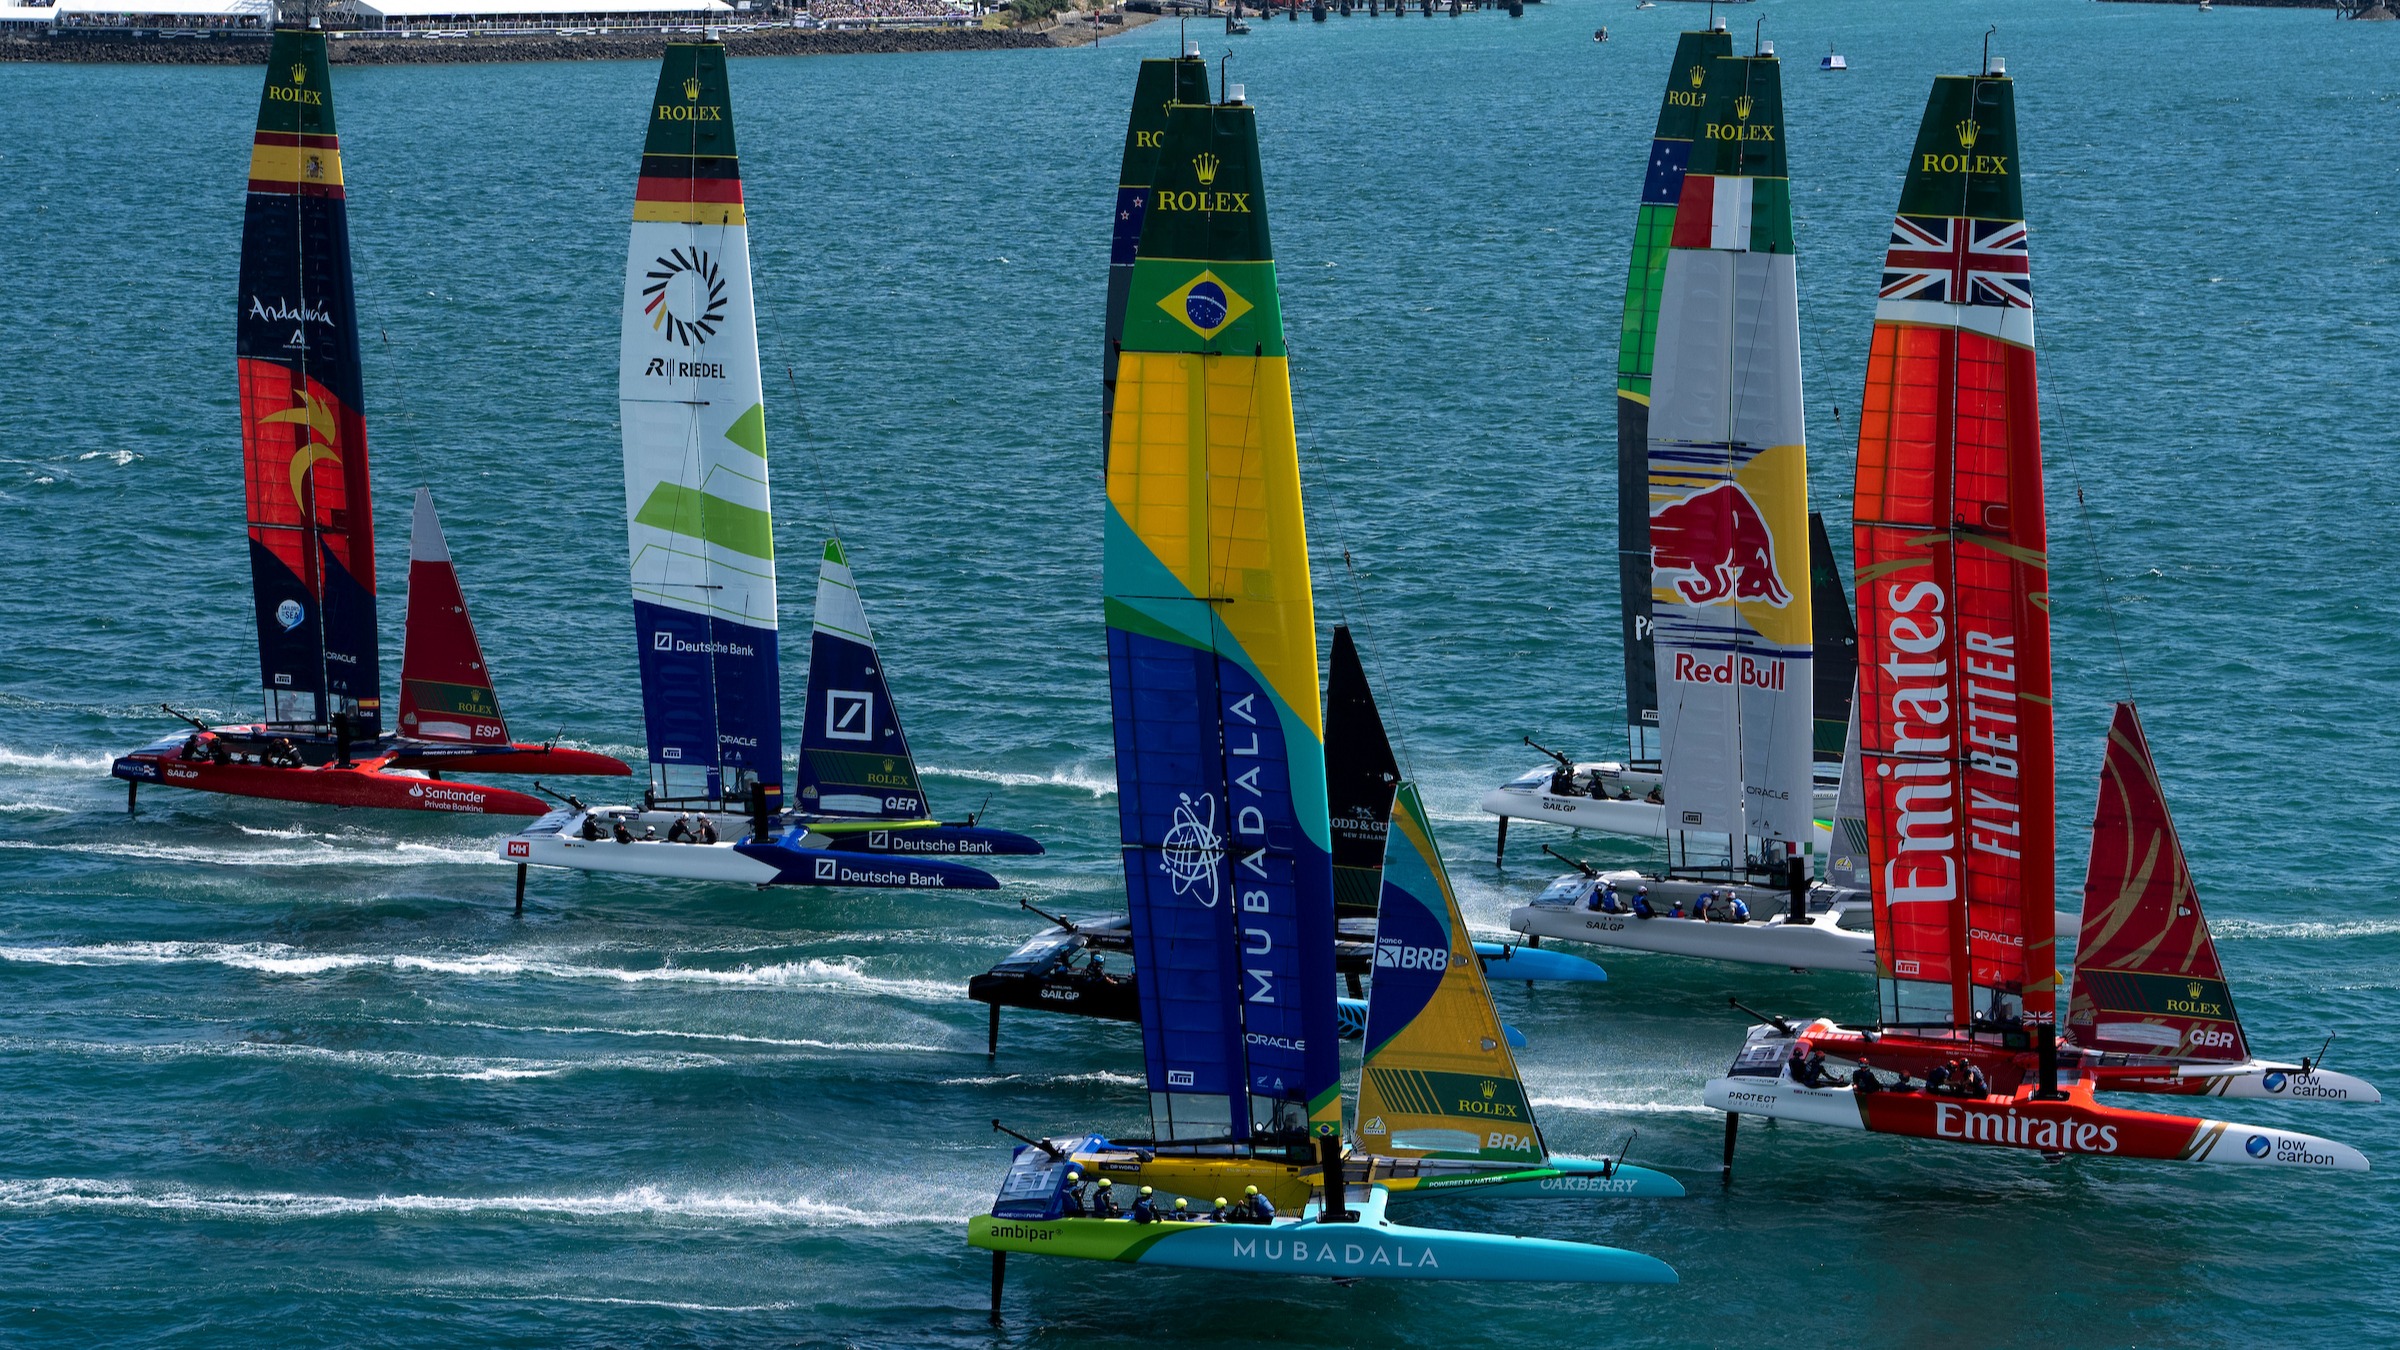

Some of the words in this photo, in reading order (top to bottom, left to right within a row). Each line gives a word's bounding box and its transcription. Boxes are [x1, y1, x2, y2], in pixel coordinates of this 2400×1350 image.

[269, 86, 322, 105] ROLEX
[1668, 90, 1707, 107] ROL
[658, 105, 721, 121] ROLEX
[1705, 123, 1775, 141] ROLEX
[1921, 153, 2008, 175] ROLEX
[1157, 191, 1251, 213] ROLEX
[249, 295, 335, 326] Andalucía
[678, 362, 726, 379] RIEDEL
[285, 611, 299, 620] SEA
[326, 651, 357, 663] ORACLE
[676, 640, 728, 654] Deutsche
[729, 643, 754, 657] Bank
[1675, 652, 1734, 684] Red
[1740, 654, 1785, 691] Bull
[458, 702, 492, 715] ROLEX
[1966, 629, 2019, 779] BETTER
[475, 724, 501, 738] ESP
[719, 734, 757, 747] ORACLE
[1877, 581, 1957, 907] Emirates
[867, 773, 908, 786] ROLEX
[425, 787, 486, 803] Santander
[1746, 786, 1789, 800] ORACLE
[425, 800, 452, 810] Private
[452, 802, 484, 813] Banking
[885, 796, 918, 811] GER
[1330, 817, 1359, 830] ODD
[1360, 820, 1369, 830] &
[1370, 821, 1388, 832] GU
[1971, 788, 2020, 860] FLY
[893, 838, 955, 852] Deutsche
[959, 840, 993, 853] Bank
[1229, 693, 1275, 1003] MUBADALA
[841, 868, 906, 885] Deutsche
[909, 871, 944, 886] Bank
[1379, 936, 1402, 945] banco
[1969, 928, 2023, 947] ORACLE
[1401, 948, 1448, 970] BRB
[2167, 1000, 2222, 1016] ROLEX
[1245, 1033, 1305, 1051] ORACLE
[2189, 1029, 2234, 1049] GBR
[2292, 1074, 2320, 1085] low
[1728, 1091, 1777, 1103] PROTECT
[2292, 1084, 2347, 1099] carbon
[1458, 1099, 1518, 1118] ROLEX
[1744, 1101, 1775, 1109] FUTURE
[1935, 1102, 2118, 1153] Emirates
[1487, 1132, 1532, 1153] BRA
[2277, 1136, 2306, 1150] low
[2277, 1150, 2334, 1166] carbon
[1429, 1180, 1463, 1188] POWERED
[1539, 1176, 1638, 1193] OAKBERRY
[1233, 1237, 1439, 1268] MUBADALA
